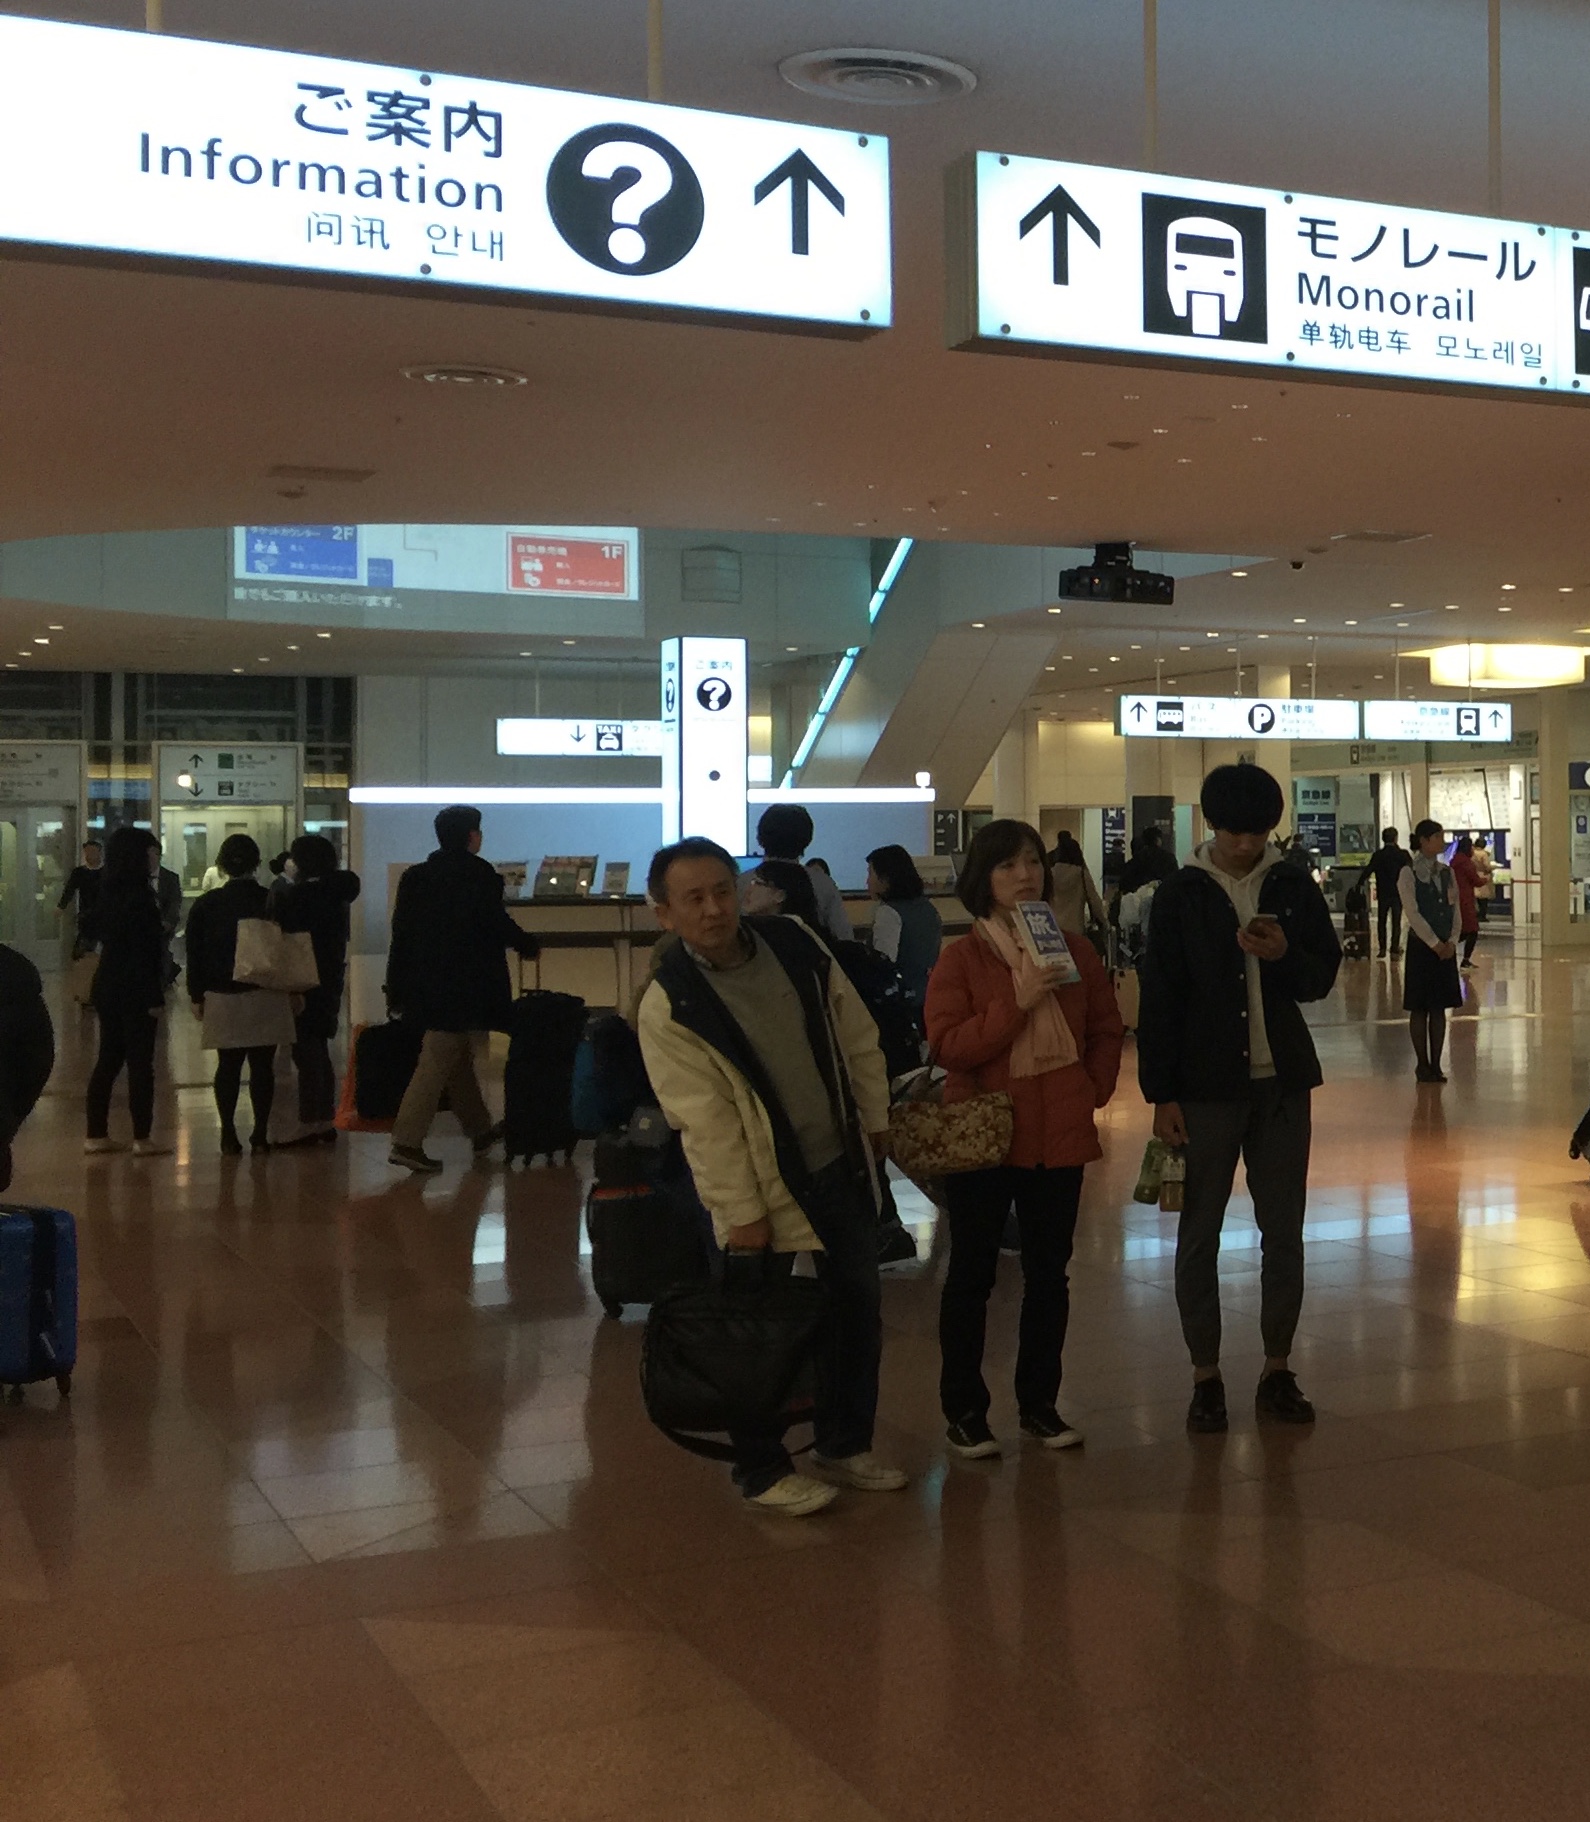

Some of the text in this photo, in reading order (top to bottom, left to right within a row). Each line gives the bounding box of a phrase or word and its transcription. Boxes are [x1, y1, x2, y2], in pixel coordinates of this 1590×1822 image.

[294, 82, 504, 158] ご案内
[140, 132, 504, 212] Information
[307, 212, 505, 263] 问讯 안내
[1298, 216, 1537, 281] モノレール
[1298, 272, 1474, 323] Monorail
[1299, 320, 1542, 369] 单轨电车 모노레일
[332, 525, 355, 541] 2F
[601, 545, 623, 559] 1F
